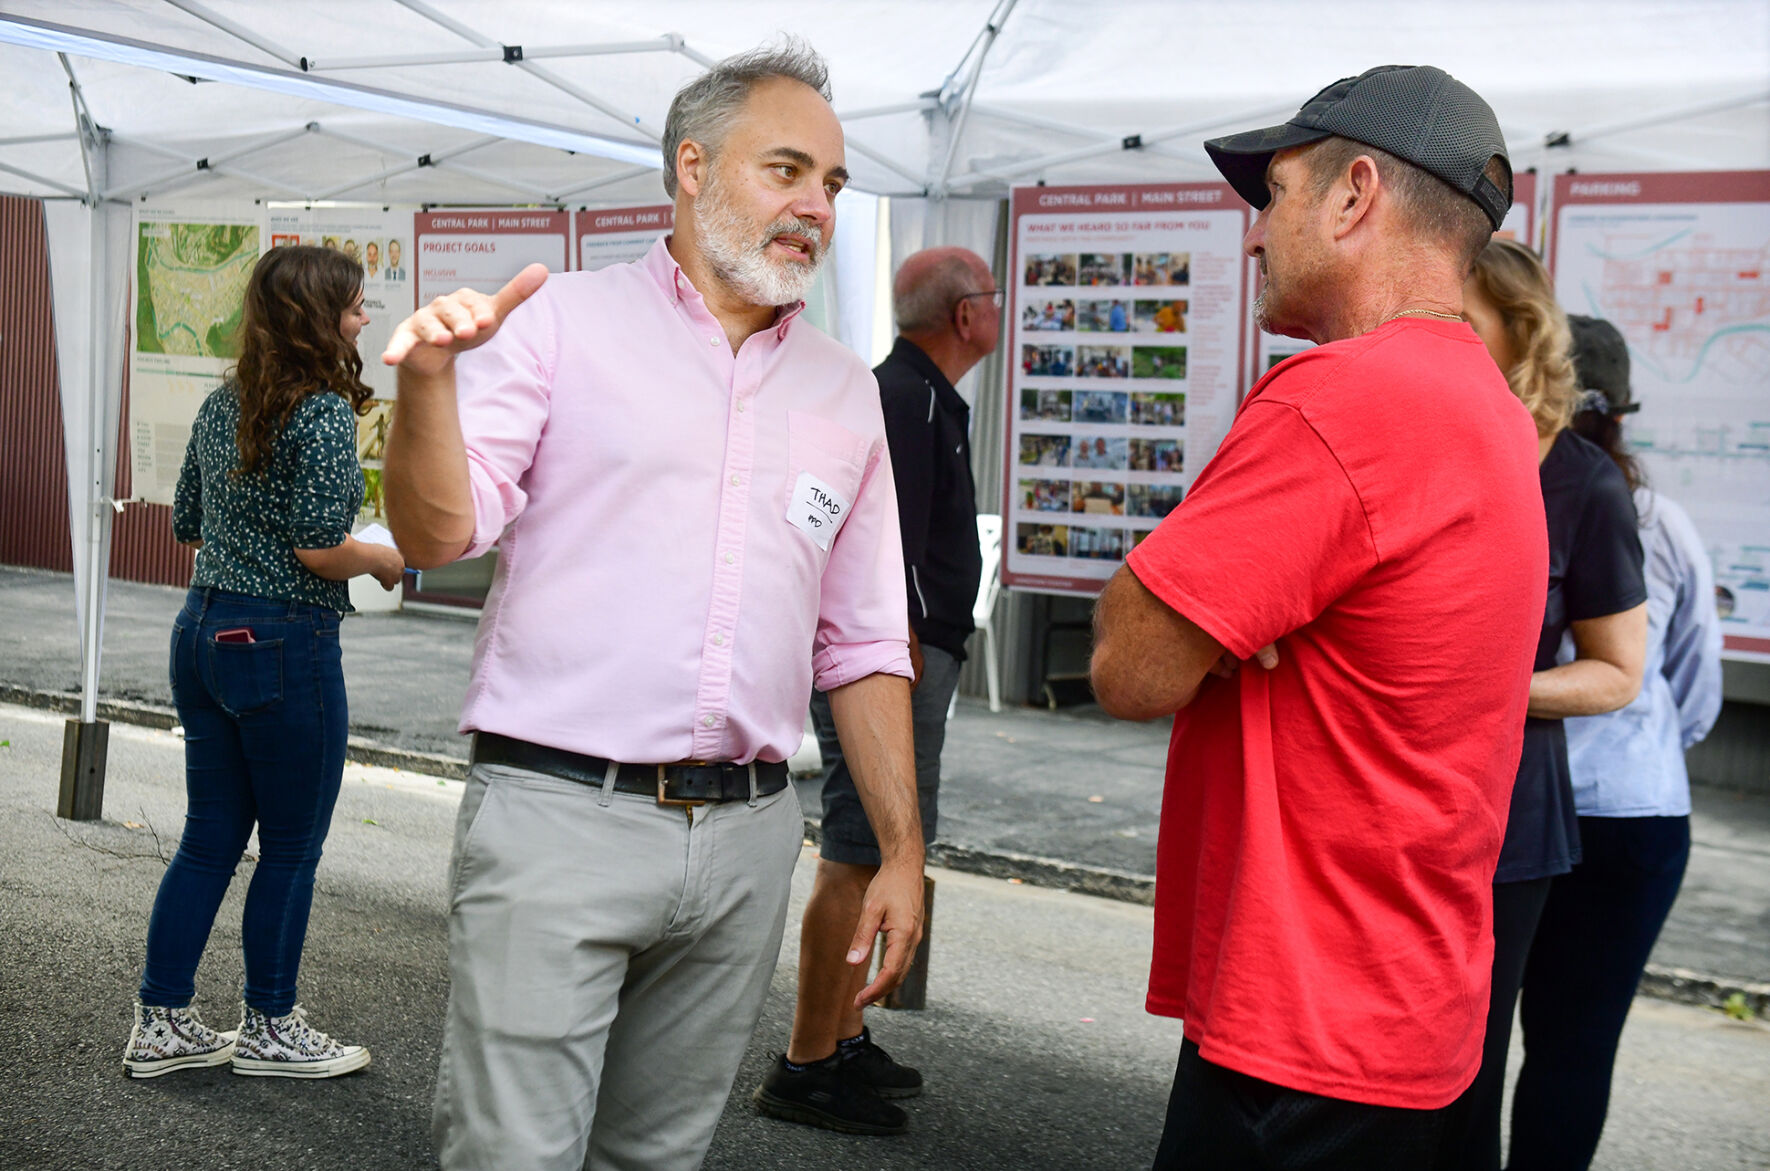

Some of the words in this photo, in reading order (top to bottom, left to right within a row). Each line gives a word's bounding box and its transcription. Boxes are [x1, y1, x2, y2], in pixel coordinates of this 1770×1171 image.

[1569, 181, 1641, 196] PARKING
[1039, 193, 1092, 206] CENTRAL
[1095, 193, 1126, 205] PARK
[1141, 192, 1174, 204] MAIN
[1177, 190, 1222, 203] STREET
[431, 218, 466, 229] CENTRAL
[468, 218, 488, 228] PARK
[498, 217, 519, 228] MAIN
[521, 217, 551, 228] STREET
[595, 215, 635, 227] CENTRAL
[636, 213, 659, 225] PARK
[1027, 223, 1056, 233] WHAT
[1059, 222, 1075, 232] WE
[1078, 222, 1111, 232] HEARD
[1115, 222, 1128, 231] SO
[1132, 221, 1152, 231] FAR
[1155, 221, 1185, 231] FROM
[1188, 220, 1211, 230] YOU
[423, 242, 462, 253] PROJECT
[464, 242, 496, 253] GOALS
[810, 487, 840, 515] THAD
